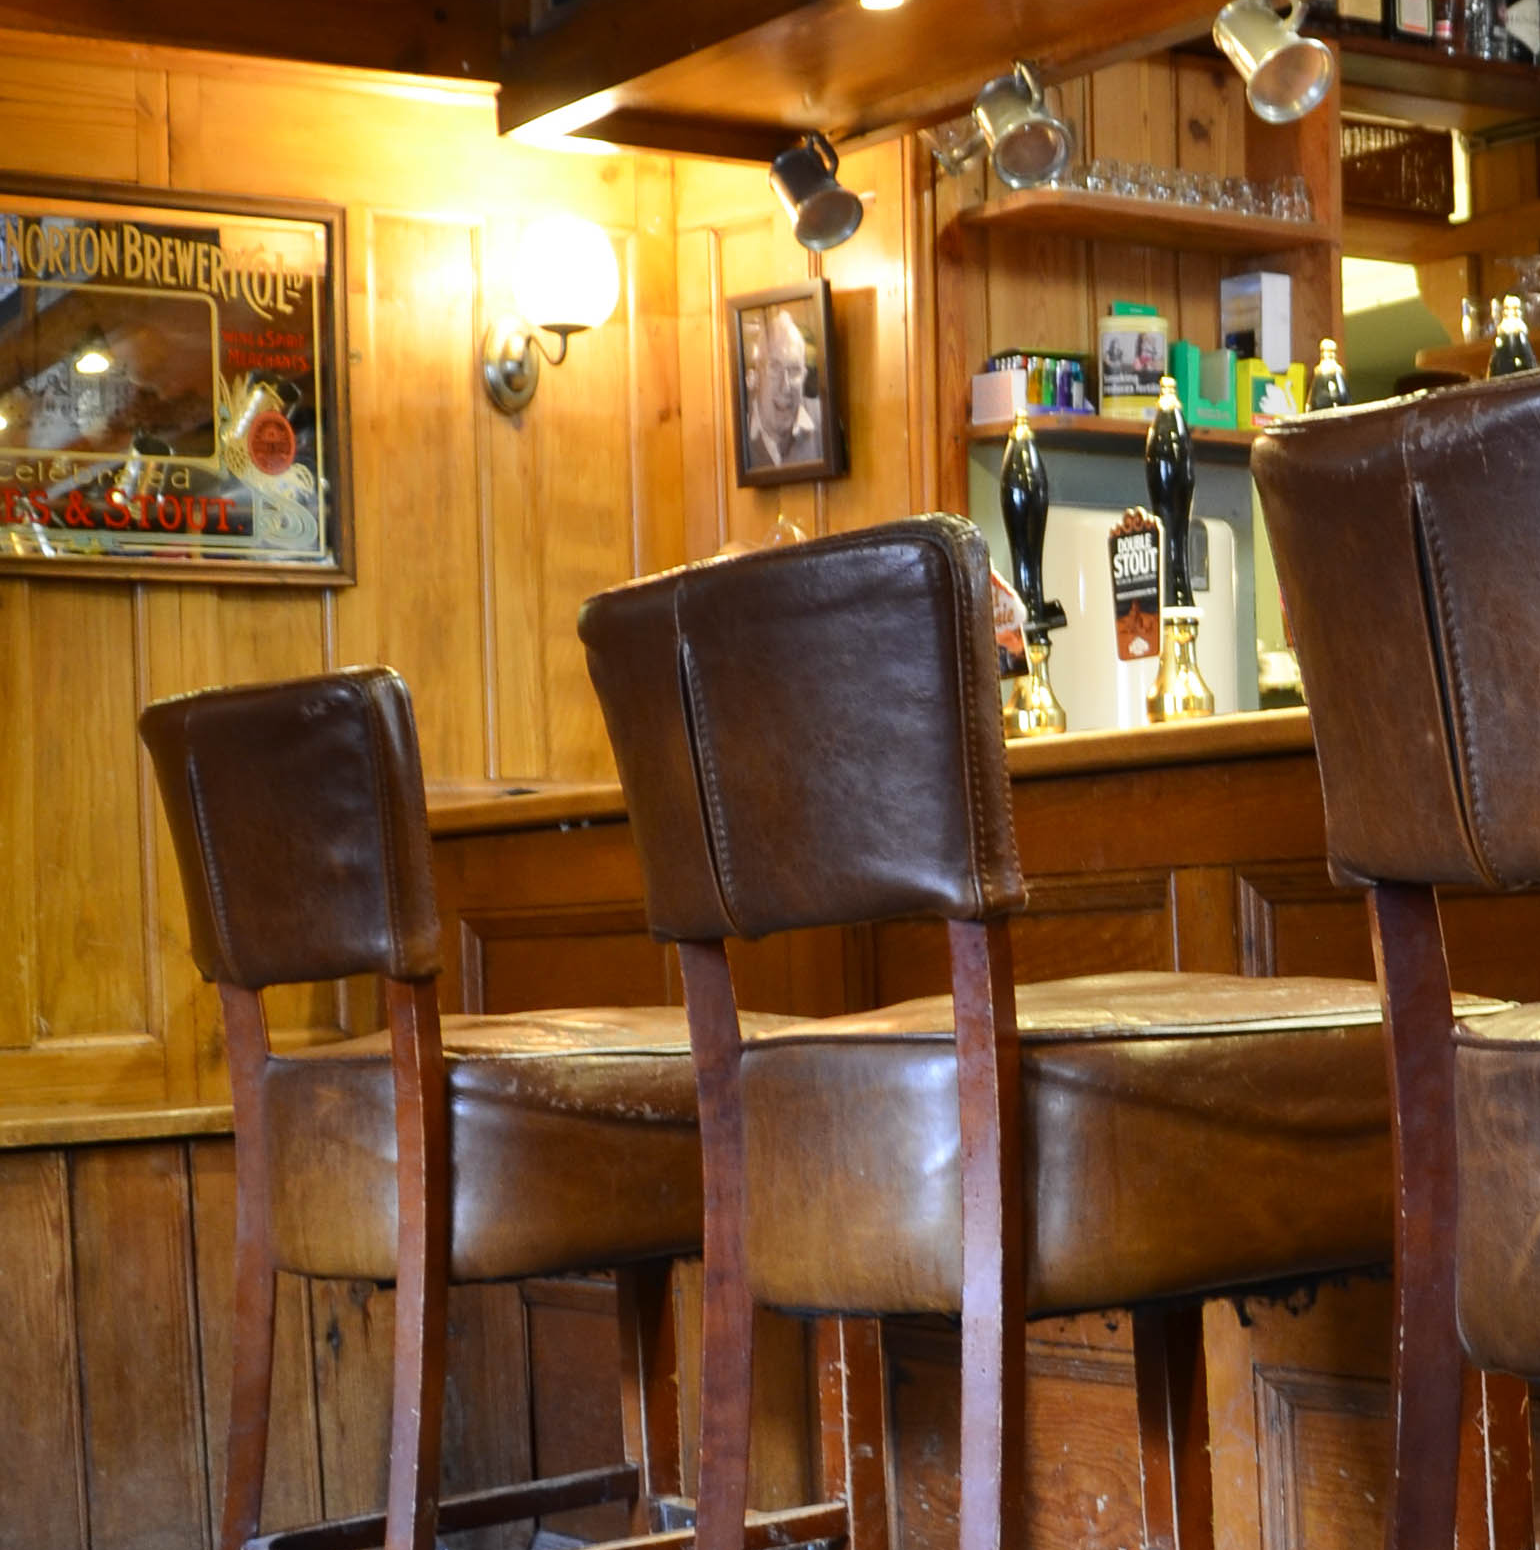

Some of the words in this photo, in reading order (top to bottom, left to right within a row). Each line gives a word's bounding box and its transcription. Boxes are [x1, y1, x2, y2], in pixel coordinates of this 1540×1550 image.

[3, 217, 119, 279] NORTON
[122, 223, 238, 303] BREWERY
[0, 489, 51, 525] ES
[64, 490, 95, 529] &
[103, 487, 245, 533] STOUT.
[1117, 532, 1152, 553] DOUBLE
[1114, 547, 1158, 579] STOUT
